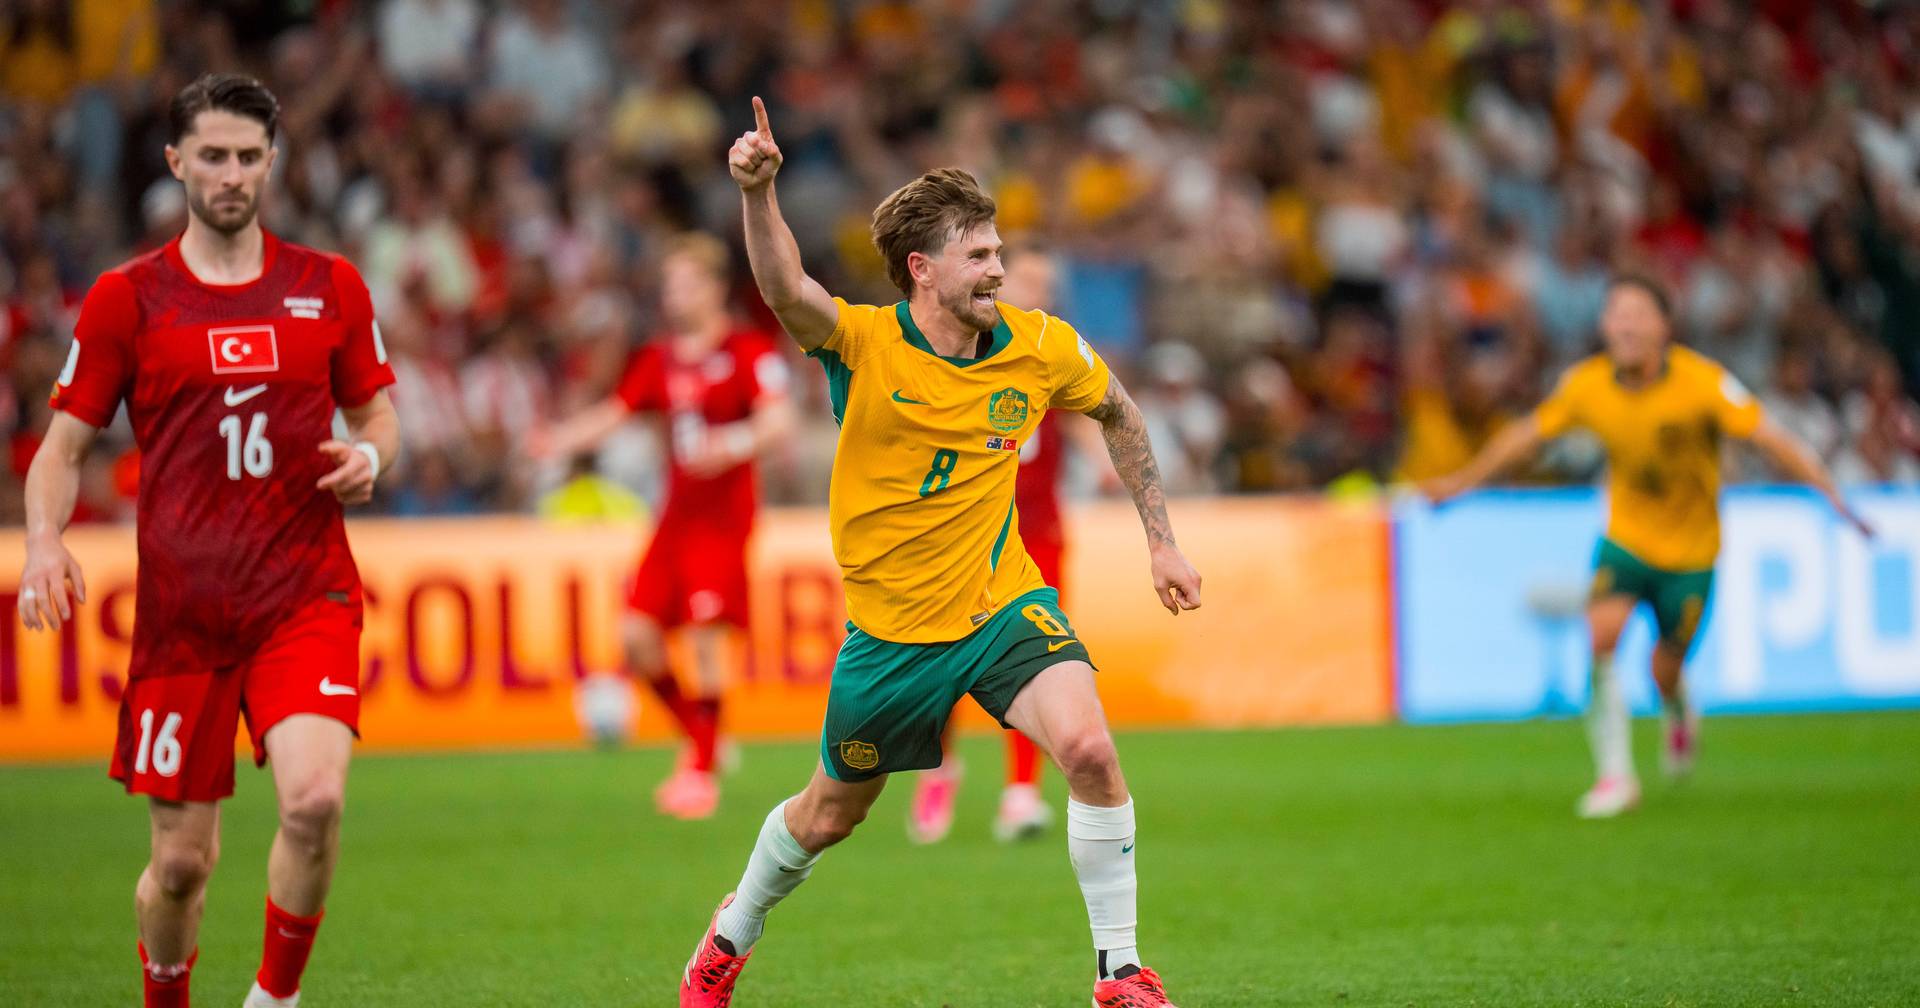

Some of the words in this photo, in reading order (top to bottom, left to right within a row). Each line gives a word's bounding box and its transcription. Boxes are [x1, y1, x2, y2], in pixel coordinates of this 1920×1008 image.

[219, 412, 273, 480] 16
[919, 448, 959, 497] 8
[1021, 603, 1069, 636] 8
[135, 708, 183, 777] 16
